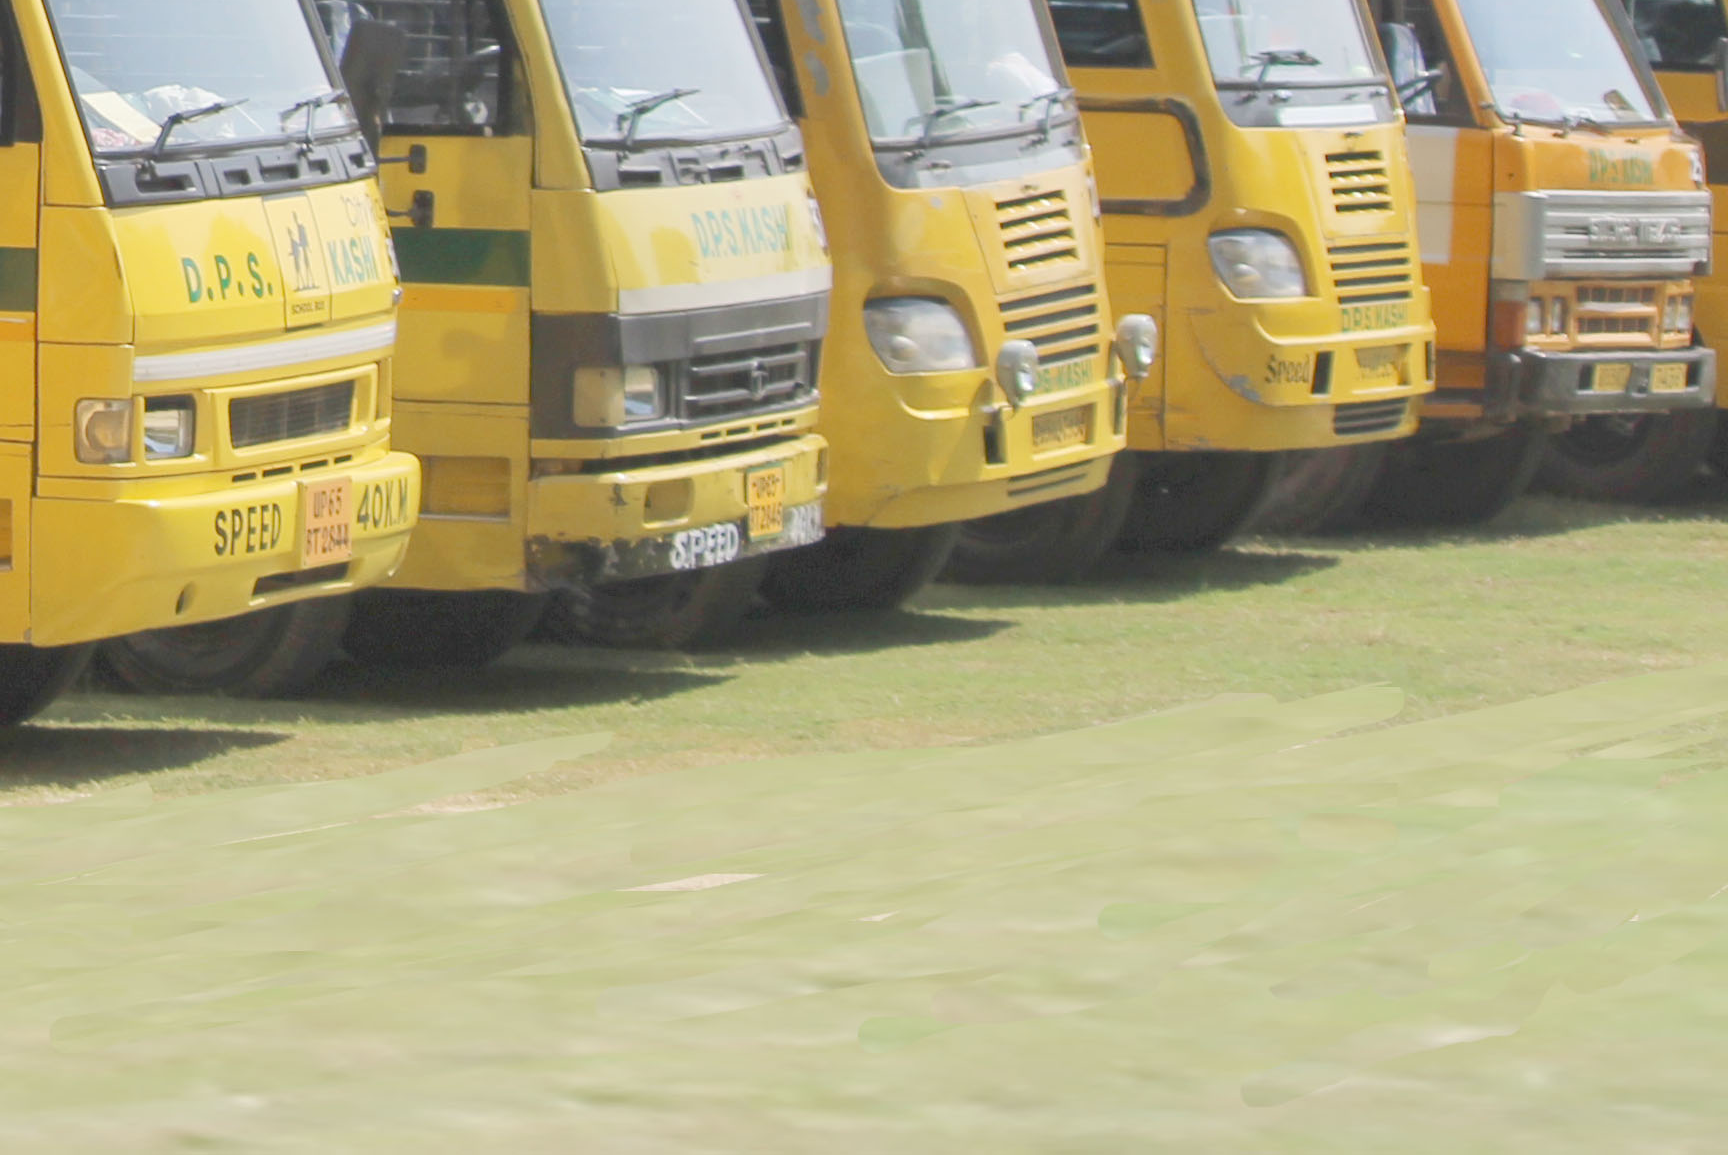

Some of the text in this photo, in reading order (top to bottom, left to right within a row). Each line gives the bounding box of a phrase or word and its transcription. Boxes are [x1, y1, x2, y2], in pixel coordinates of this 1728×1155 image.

[181, 235, 381, 304] D.P.S. KASHI
[1264, 353, 1311, 385] Speed
[313, 486, 343, 519] UP65
[214, 502, 282, 557] SPEED
[670, 522, 740, 570] SPEED
